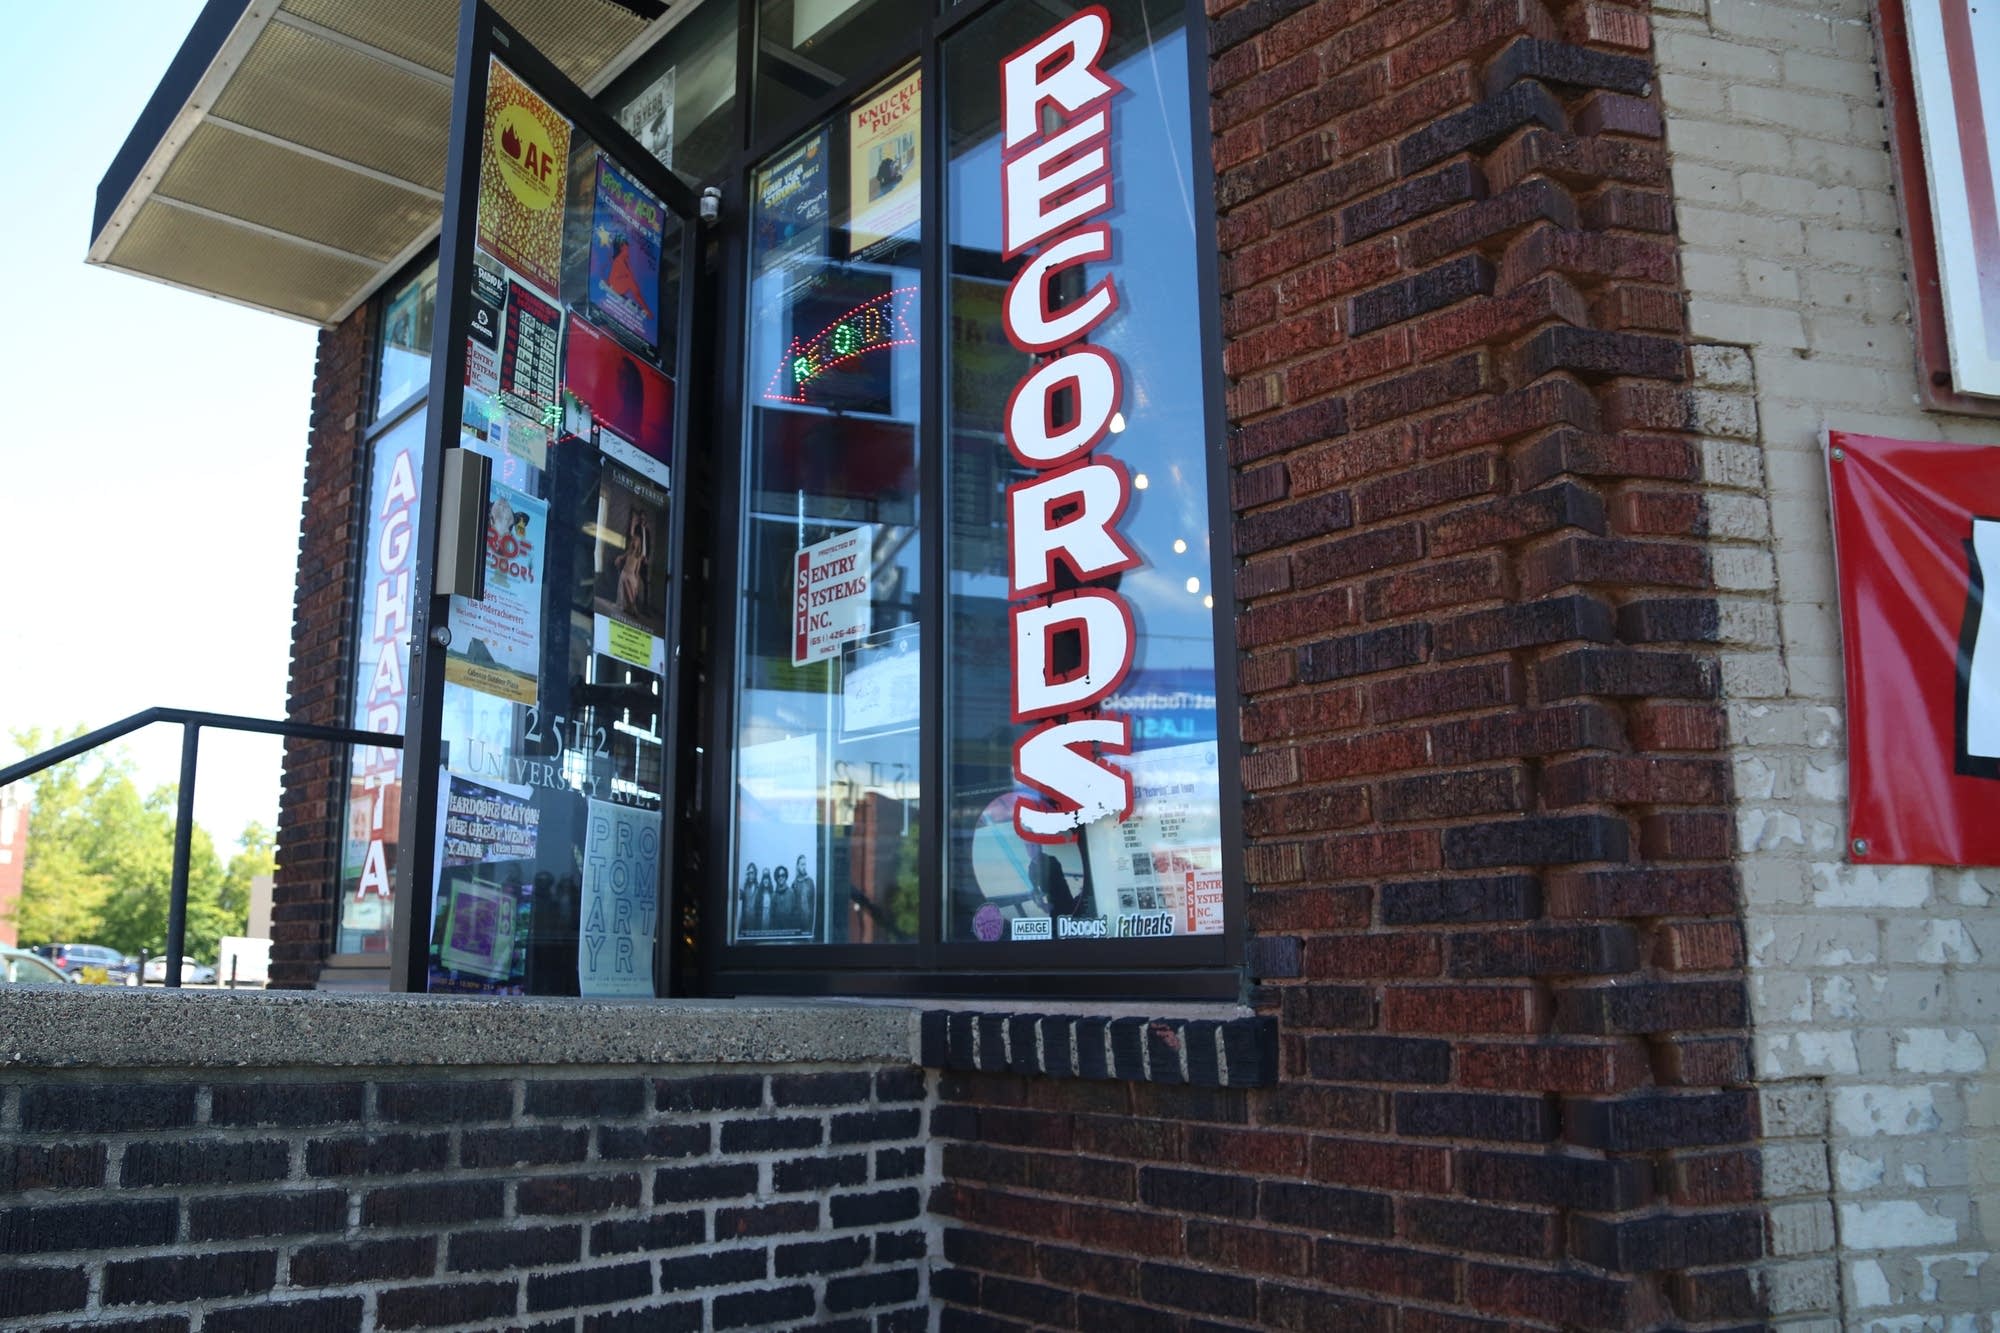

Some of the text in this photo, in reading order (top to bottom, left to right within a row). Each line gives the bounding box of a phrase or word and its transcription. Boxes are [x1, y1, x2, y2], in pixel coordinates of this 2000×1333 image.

[872, 100, 911, 133] PUCK
[794, 302, 894, 382] RECORDS
[1001, 4, 1143, 845] RECORDS
[799, 554, 857, 589] SENTRY
[798, 576, 867, 613] SYSTEMS
[798, 611, 832, 637] INC.
[355, 449, 418, 900] AGHARTA
[525, 708, 610, 761] 2512
[467, 738, 600, 797] UNVERSY
[448, 791, 501, 819] HARDCORE
[447, 816, 532, 845] THE GREAT WENT
[1187, 880, 1223, 892] SENTR
[1188, 894, 1223, 905] SYSTE
[1016, 922, 1048, 933] MERGE
[1059, 916, 1107, 938] Discogs
[1118, 913, 1173, 938] fatbeats
